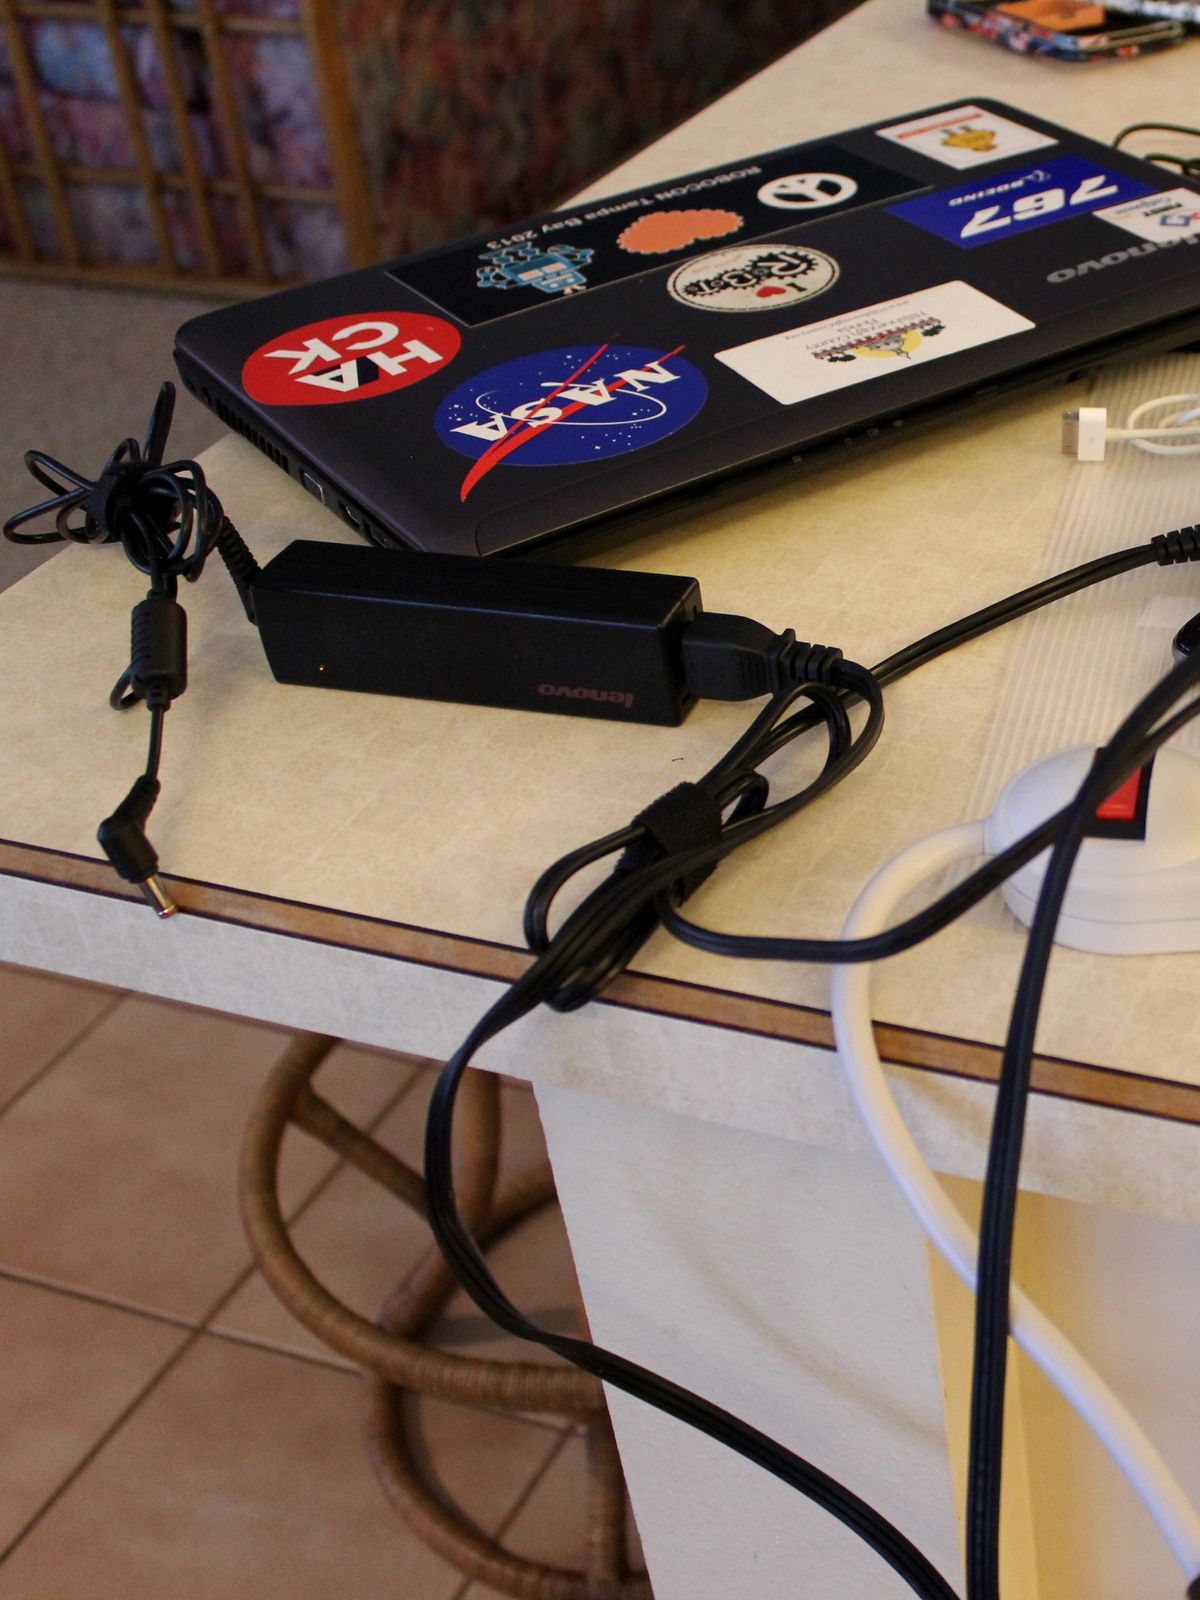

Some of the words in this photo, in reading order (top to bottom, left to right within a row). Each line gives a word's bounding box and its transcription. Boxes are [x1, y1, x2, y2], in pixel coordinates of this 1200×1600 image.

[655, 165, 762, 201] ROBOCON
[948, 180, 1024, 207] BOEING
[585, 197, 651, 221] Tampa
[959, 174, 1119, 239] 767
[541, 216, 583, 234] Bay
[486, 228, 539, 250] 2013
[786, 280, 808, 293] I
[449, 361, 681, 442] NASA
[537, 683, 635, 708] lenovo
